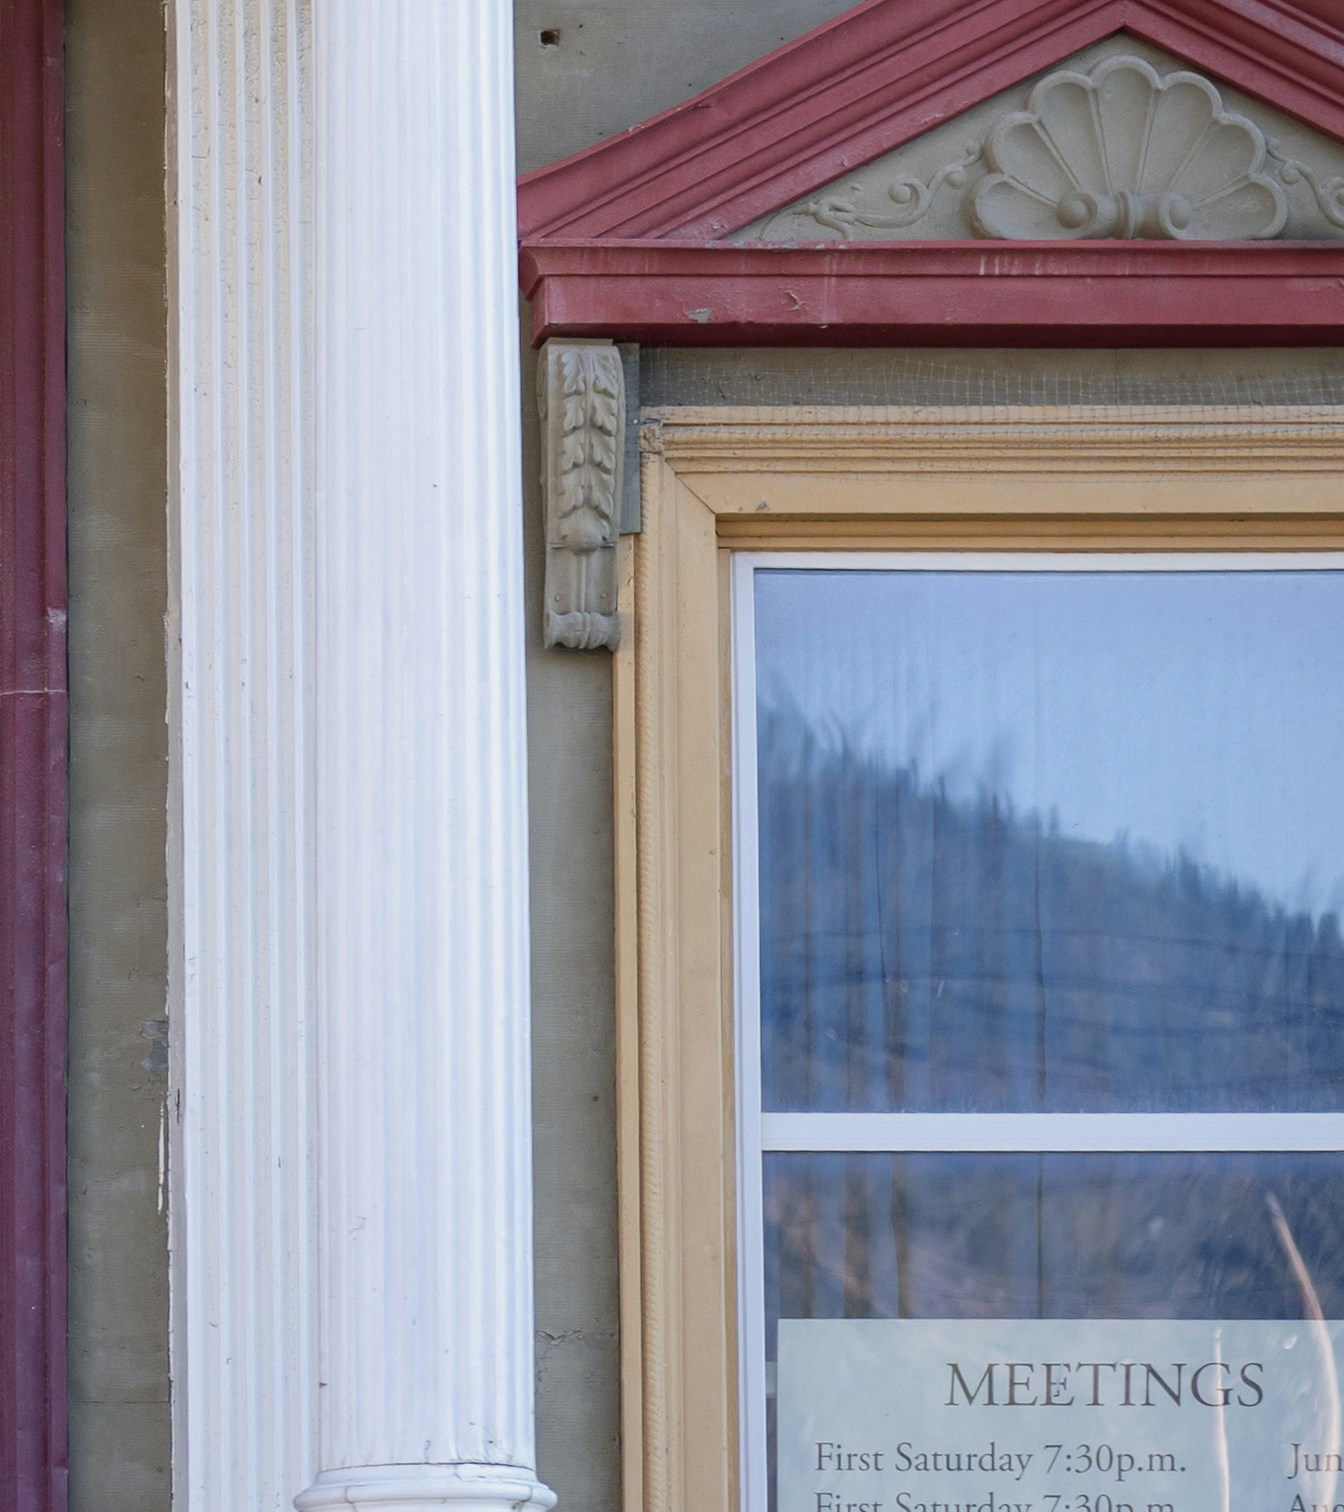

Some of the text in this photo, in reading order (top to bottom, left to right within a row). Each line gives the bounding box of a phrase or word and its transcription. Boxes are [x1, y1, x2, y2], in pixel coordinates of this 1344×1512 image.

[944, 1362, 1265, 1409] MEETINGS
[815, 1442, 1187, 1484] First Saturday 7:30p.m.
